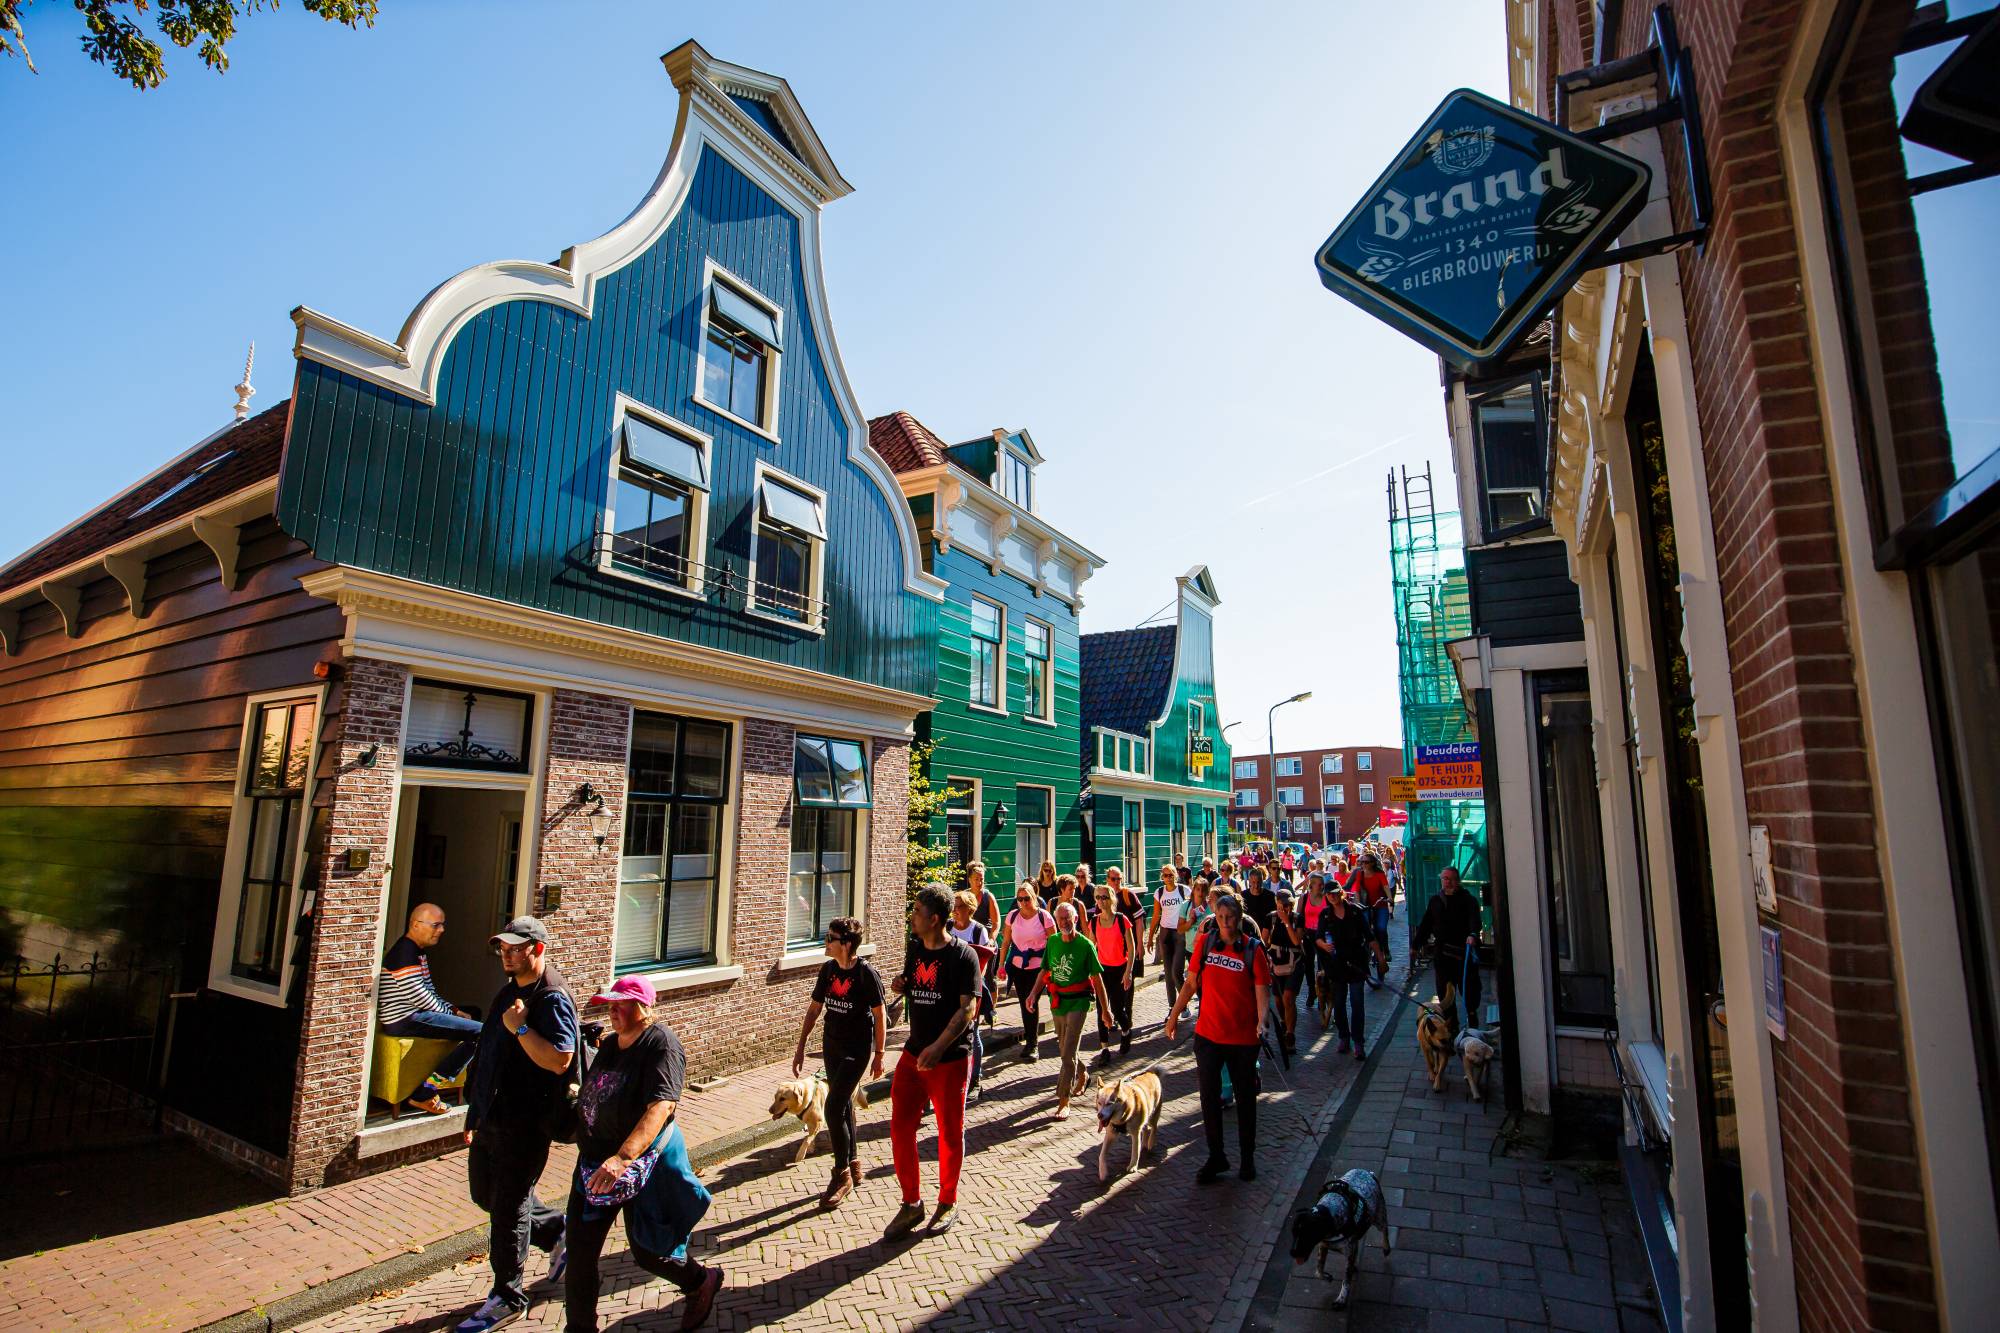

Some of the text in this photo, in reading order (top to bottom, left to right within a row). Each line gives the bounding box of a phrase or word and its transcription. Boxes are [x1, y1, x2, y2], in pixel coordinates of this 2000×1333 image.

[1374, 147, 1572, 240] Brand
[1445, 230, 1499, 254] 1340
[1402, 244, 1551, 291] BIERBROUWERIJ
[1426, 744, 1478, 756] beudeker
[1431, 764, 1474, 775] TE HUUR
[1418, 776, 1458, 786] 075-621
[1460, 774, 1472, 784] 77
[1420, 790, 1482, 798] www.beudeker.nl
[1206, 956, 1242, 970] adidas
